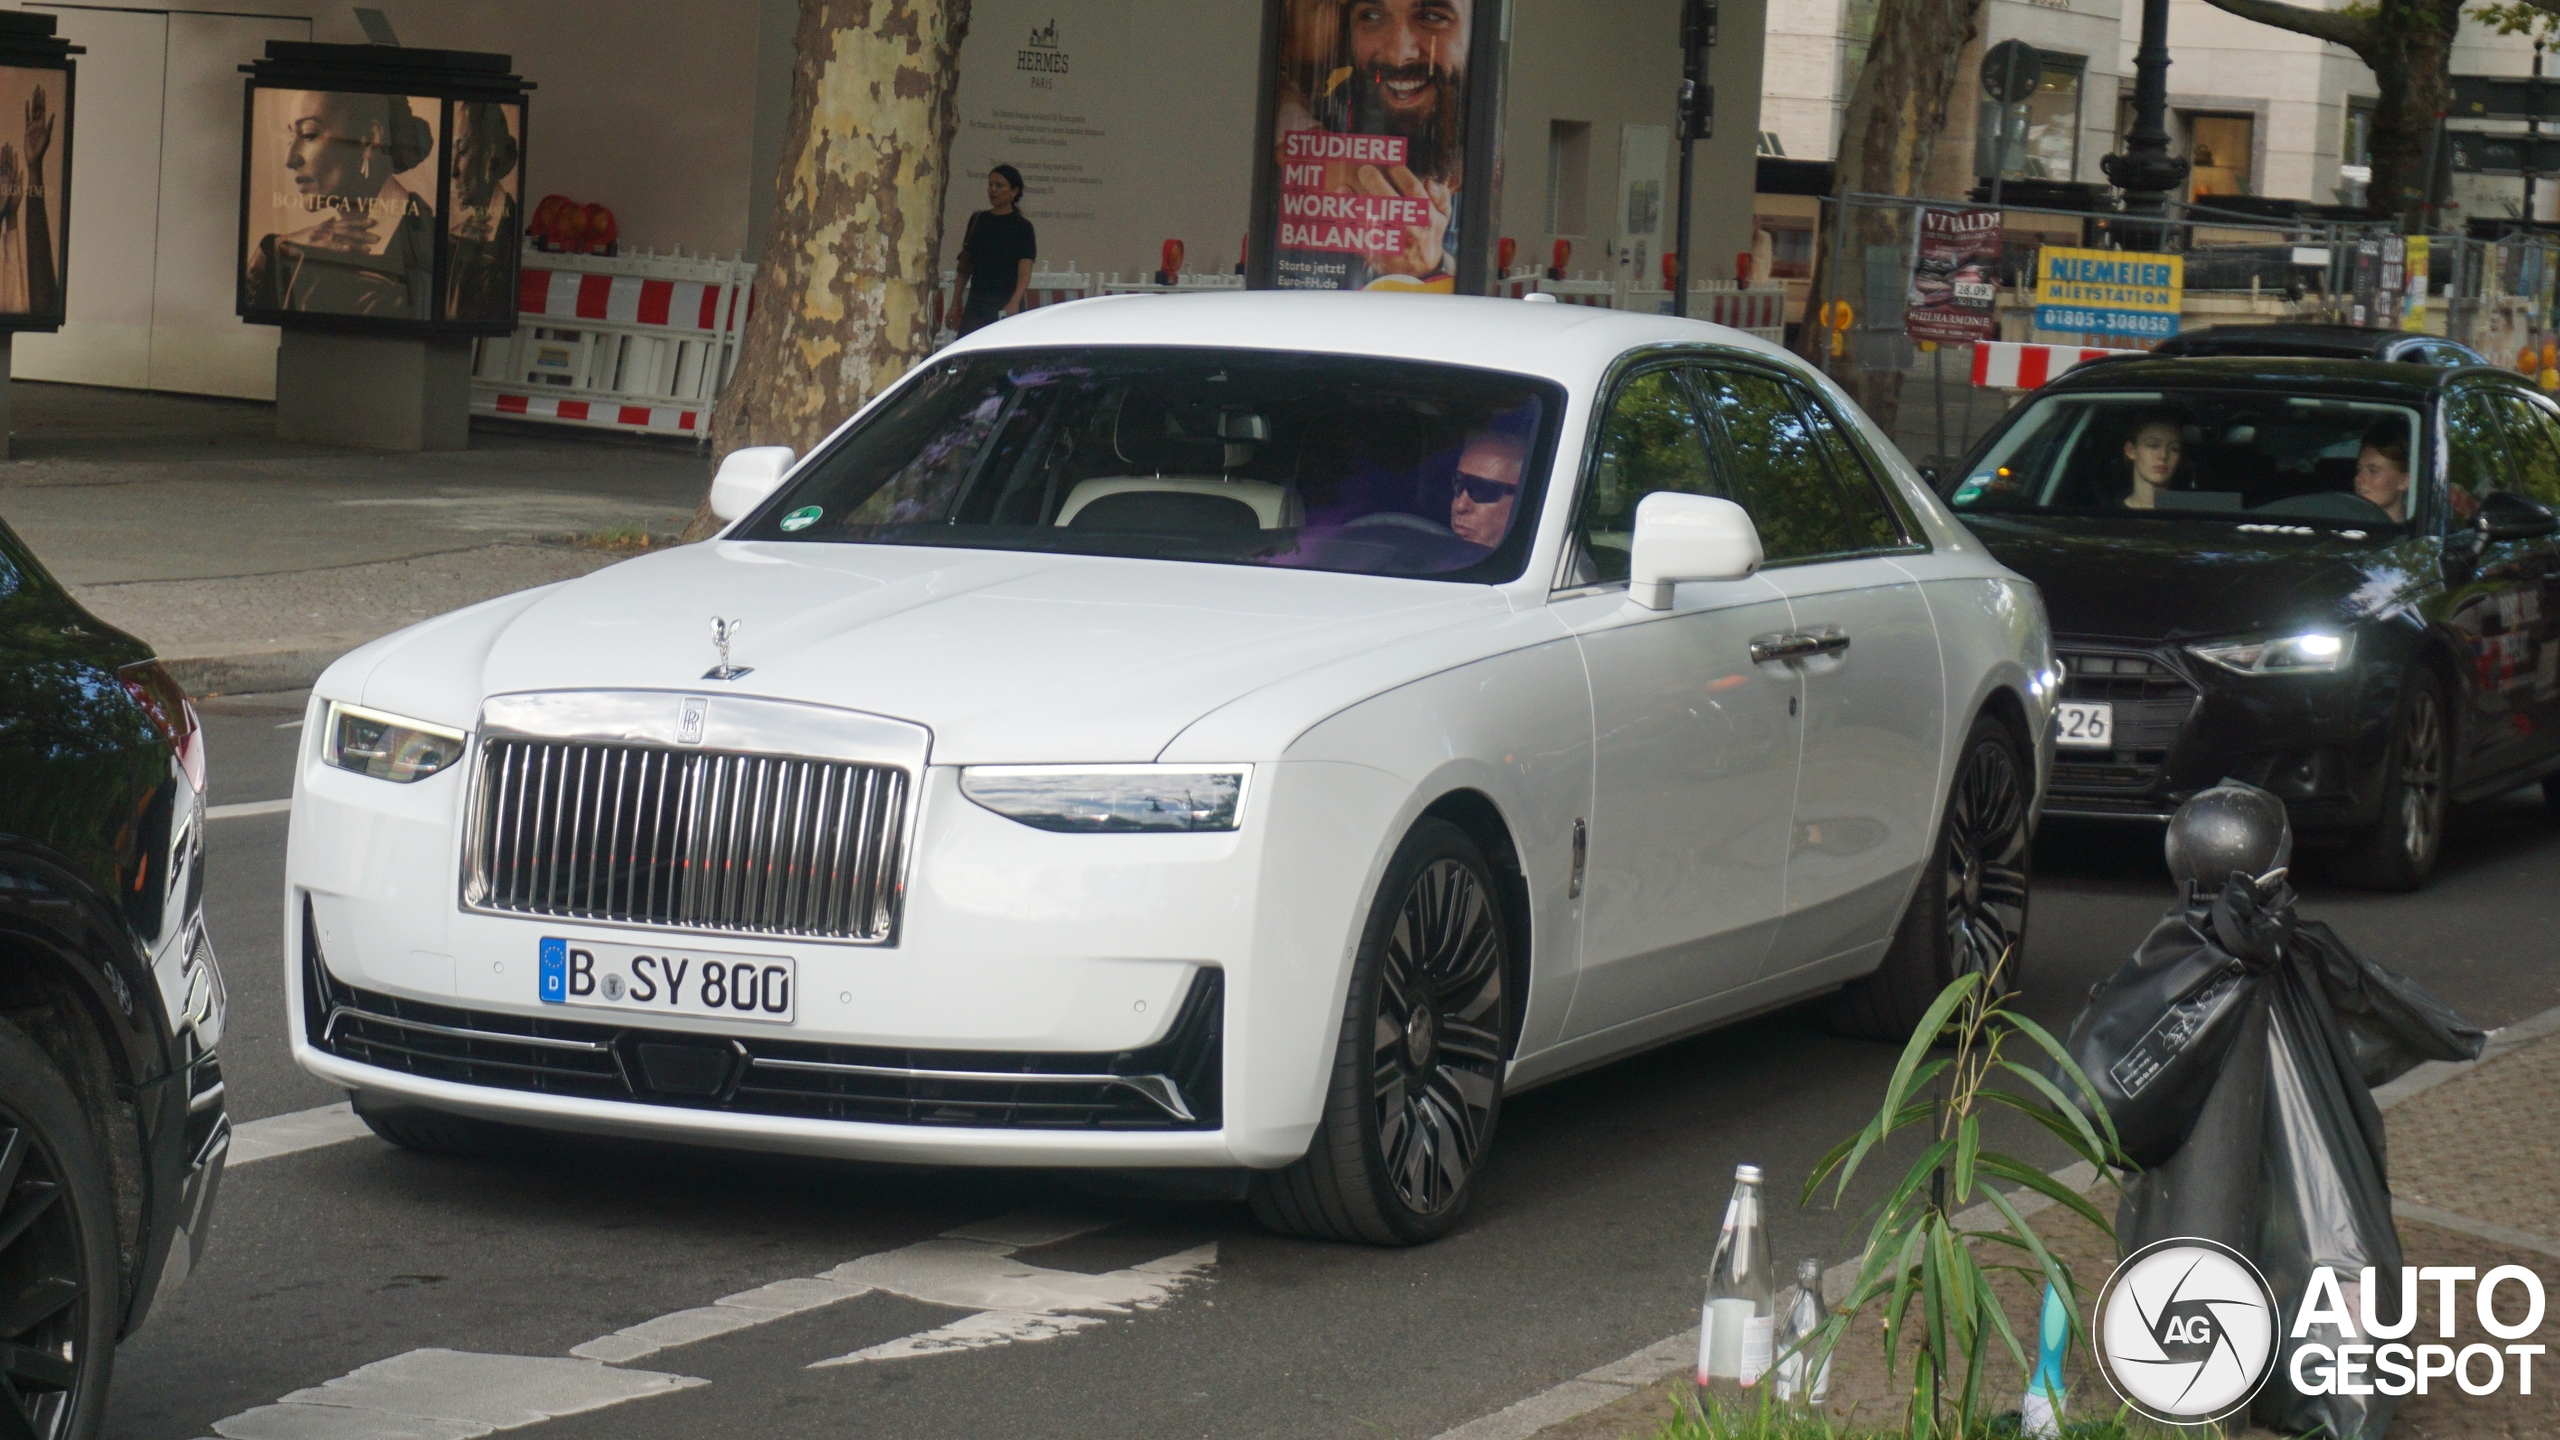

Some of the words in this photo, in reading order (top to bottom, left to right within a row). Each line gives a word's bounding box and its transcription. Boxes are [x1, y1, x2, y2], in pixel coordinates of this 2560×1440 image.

[1017, 50, 1069, 73] HERMÈS
[1030, 76, 1053, 90] PARIS
[1286, 134, 1403, 162] STUDIERE
[1285, 164, 1324, 187] MIT
[272, 191, 350, 212] BOTTEGA
[357, 196, 419, 217] VENETA
[1283, 193, 1427, 222] WORK-LIFE-
[1281, 223, 1401, 251] BALANCE
[1278, 259, 1312, 273] Starte
[1312, 261, 1346, 274] jetzt!
[2050, 257, 2171, 287] NIEMEIER
[1277, 275, 1339, 290] Euro-FH.de
[1957, 284, 1990, 297] 28.09.
[2048, 283, 2170, 305] MIETSTATION
[2045, 309, 2170, 332] 01805-308050
[549, 975, 558, 991] D
[569, 948, 596, 996] B
[629, 954, 689, 1005] SY
[700, 960, 789, 1013] 800
